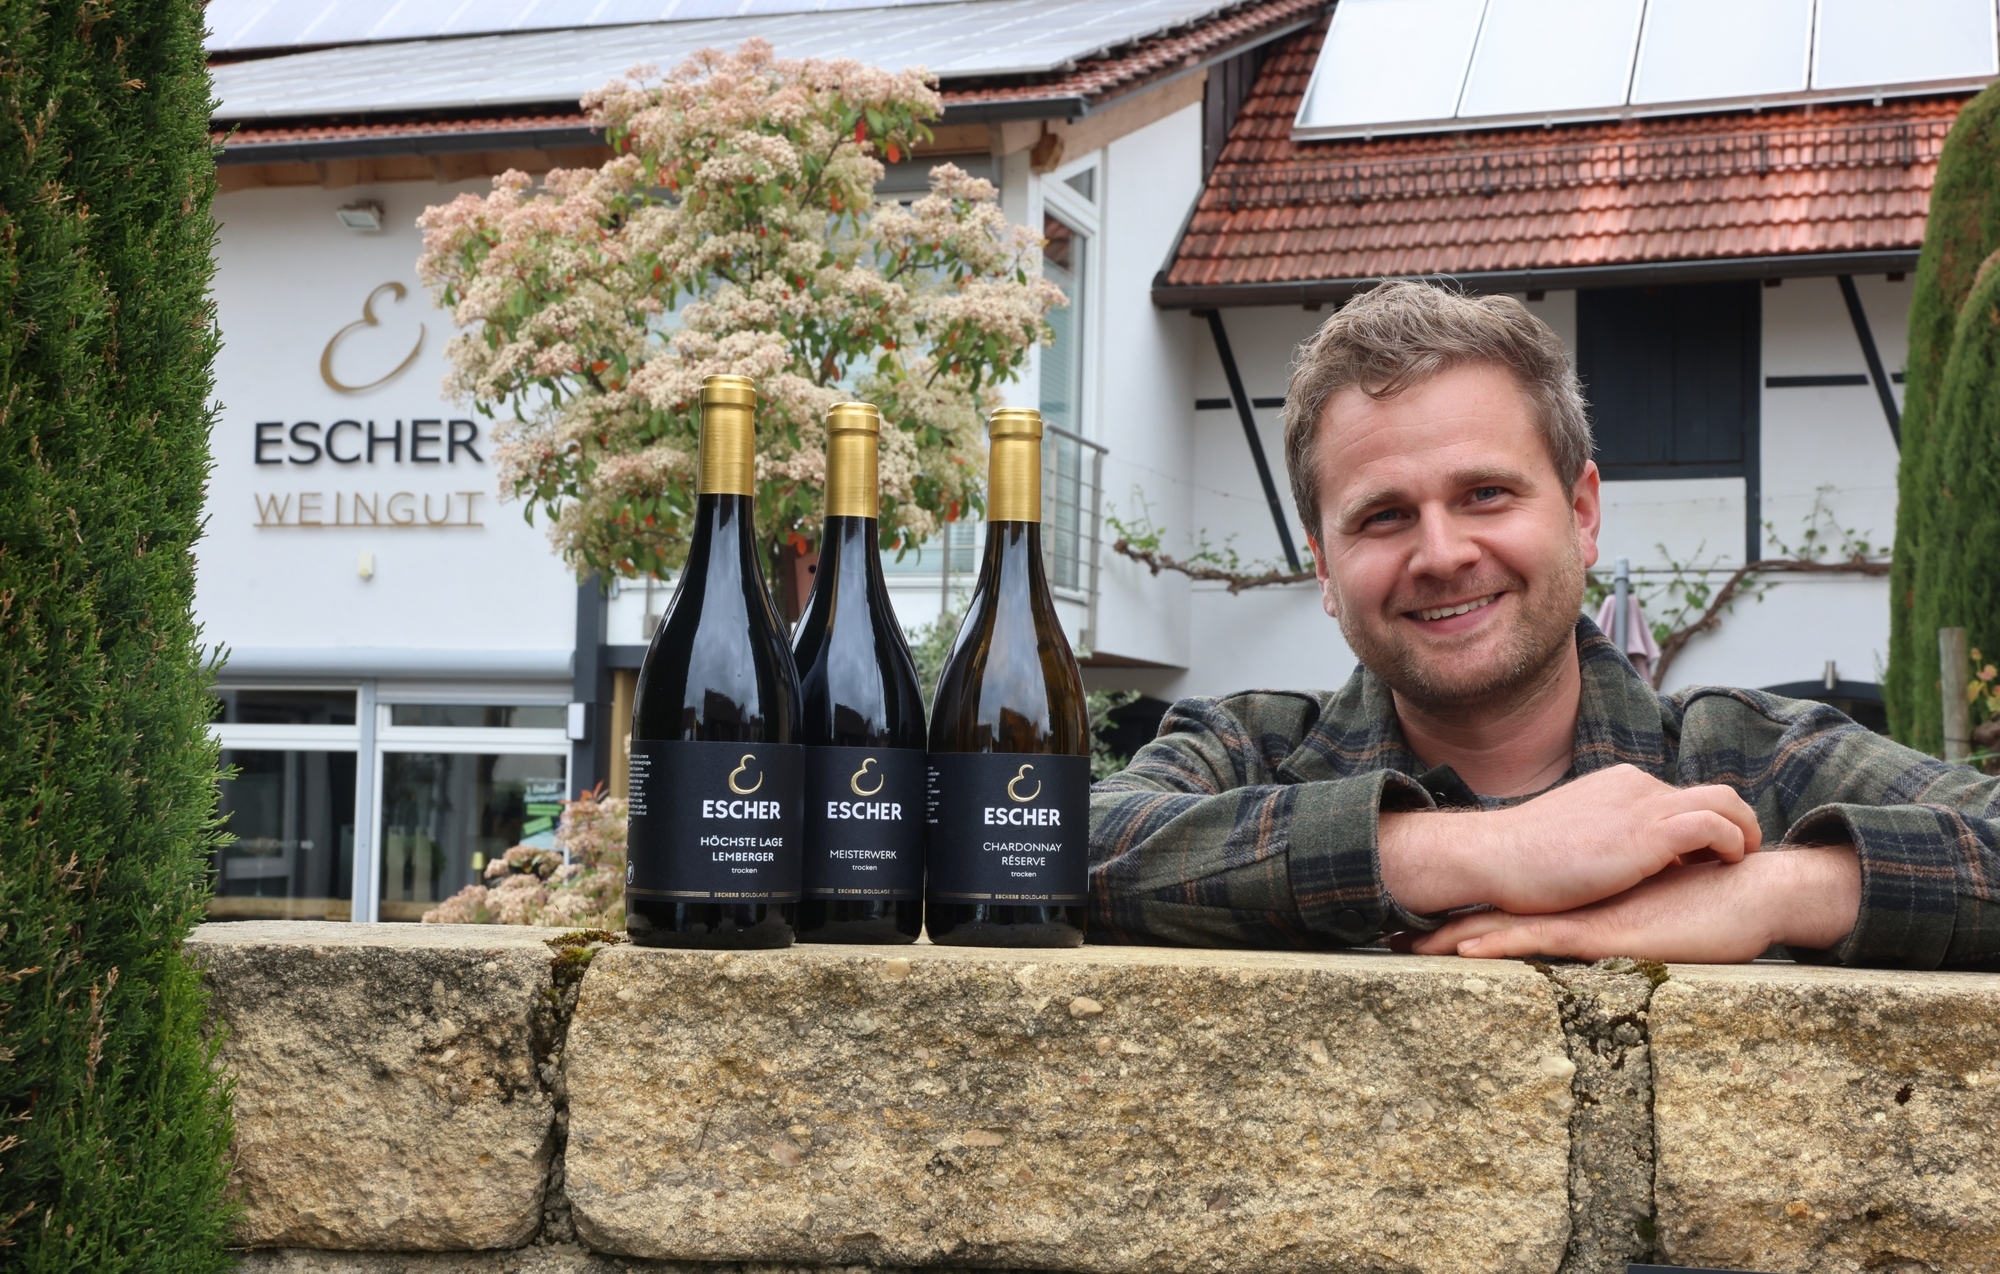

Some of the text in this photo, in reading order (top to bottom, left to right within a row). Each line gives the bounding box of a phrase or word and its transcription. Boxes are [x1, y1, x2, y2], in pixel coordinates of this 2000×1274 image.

[254, 419, 484, 466] ESCHER
[254, 491, 485, 527] WEINGUT
[702, 799, 781, 820] ESCHER
[827, 801, 903, 821] ESCHER
[984, 807, 1061, 826] ESCHER
[700, 834, 783, 847] HÖCHSTE LAGE
[983, 842, 1062, 852] CHARDONNAY
[712, 851, 774, 862] LEMBERGER
[829, 849, 898, 860] MEISTERWERK
[1001, 854, 1046, 867] RÉSERVE
[731, 866, 758, 874] trocken
